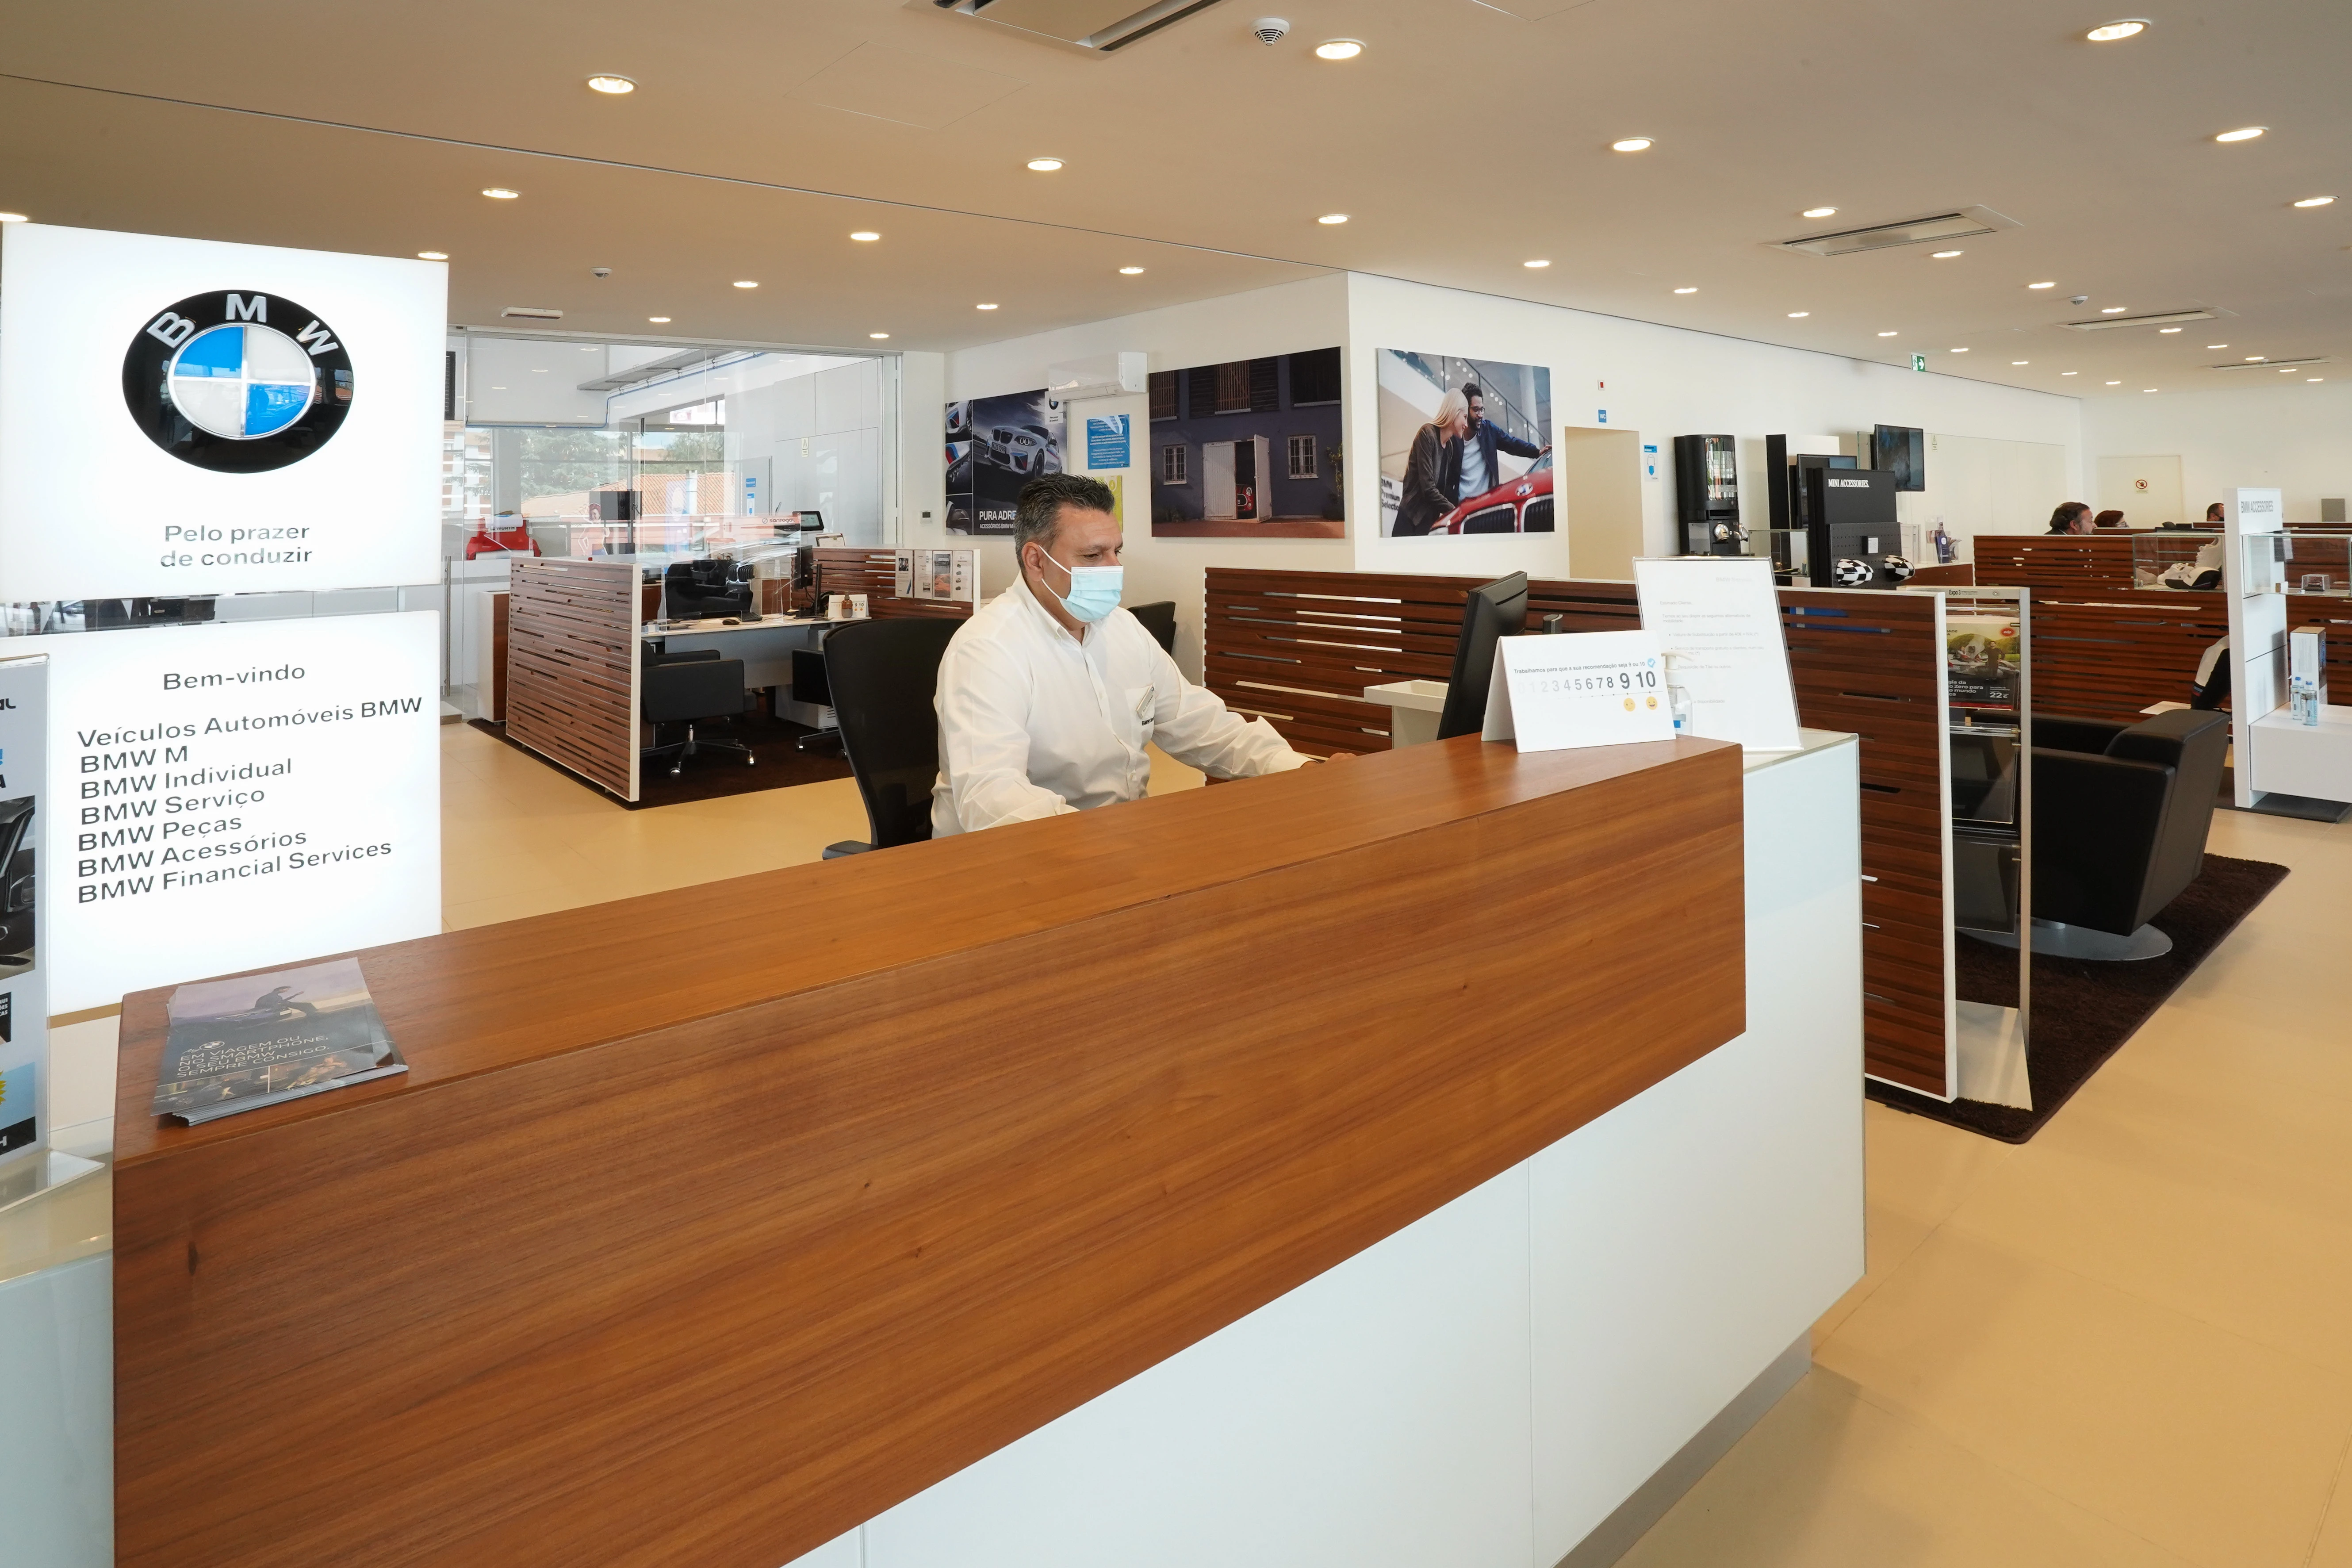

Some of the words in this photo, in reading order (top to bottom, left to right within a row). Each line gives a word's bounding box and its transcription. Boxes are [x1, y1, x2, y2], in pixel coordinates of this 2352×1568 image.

[146, 294, 339, 357] BMW
[1828, 479, 1839, 487] MINI
[979, 510, 997, 520] PURA
[2241, 501, 2250, 513] BMW
[2250, 500, 2274, 513] ACCESSORIES
[166, 525, 222, 541] Pelo
[231, 528, 309, 544] prazer
[161, 550, 193, 567] de
[201, 547, 312, 565] conduzir
[164, 664, 304, 690] Bem-vindo
[1541, 681, 1549, 693] 2
[1552, 680, 1559, 692] 3
[1564, 679, 1571, 691] 4
[1574, 679, 1582, 690] 5
[1586, 678, 1593, 690] 6
[1596, 677, 1603, 689] 7
[1606, 677, 1614, 688] 8
[1619, 672, 1630, 689] 9
[1636, 671, 1656, 688] 10
[78, 724, 195, 747] Veículos
[204, 705, 353, 735] Automóveis
[362, 698, 421, 717] BMW
[81, 749, 156, 773] BMW
[166, 746, 187, 763] M
[82, 774, 156, 799] BMW
[166, 759, 290, 788] Individual
[82, 800, 156, 824] BMW
[166, 791, 264, 813] Serviço
[79, 825, 154, 851] BMW
[164, 818, 241, 839] Peças
[79, 851, 153, 877] BMW
[161, 833, 306, 865] Acessórios
[79, 876, 153, 903] BMW
[164, 856, 280, 889] Financial
[290, 843, 391, 869] Services
[210, 1041, 272, 1056] VIAGEM
[277, 1035, 300, 1044] OU
[177, 1061, 248, 1078] SEMPRE
[253, 1045, 329, 1064] CONSIGO.
[196, 1059, 229, 1069] SEU
[235, 1050, 275, 1062] BMW
